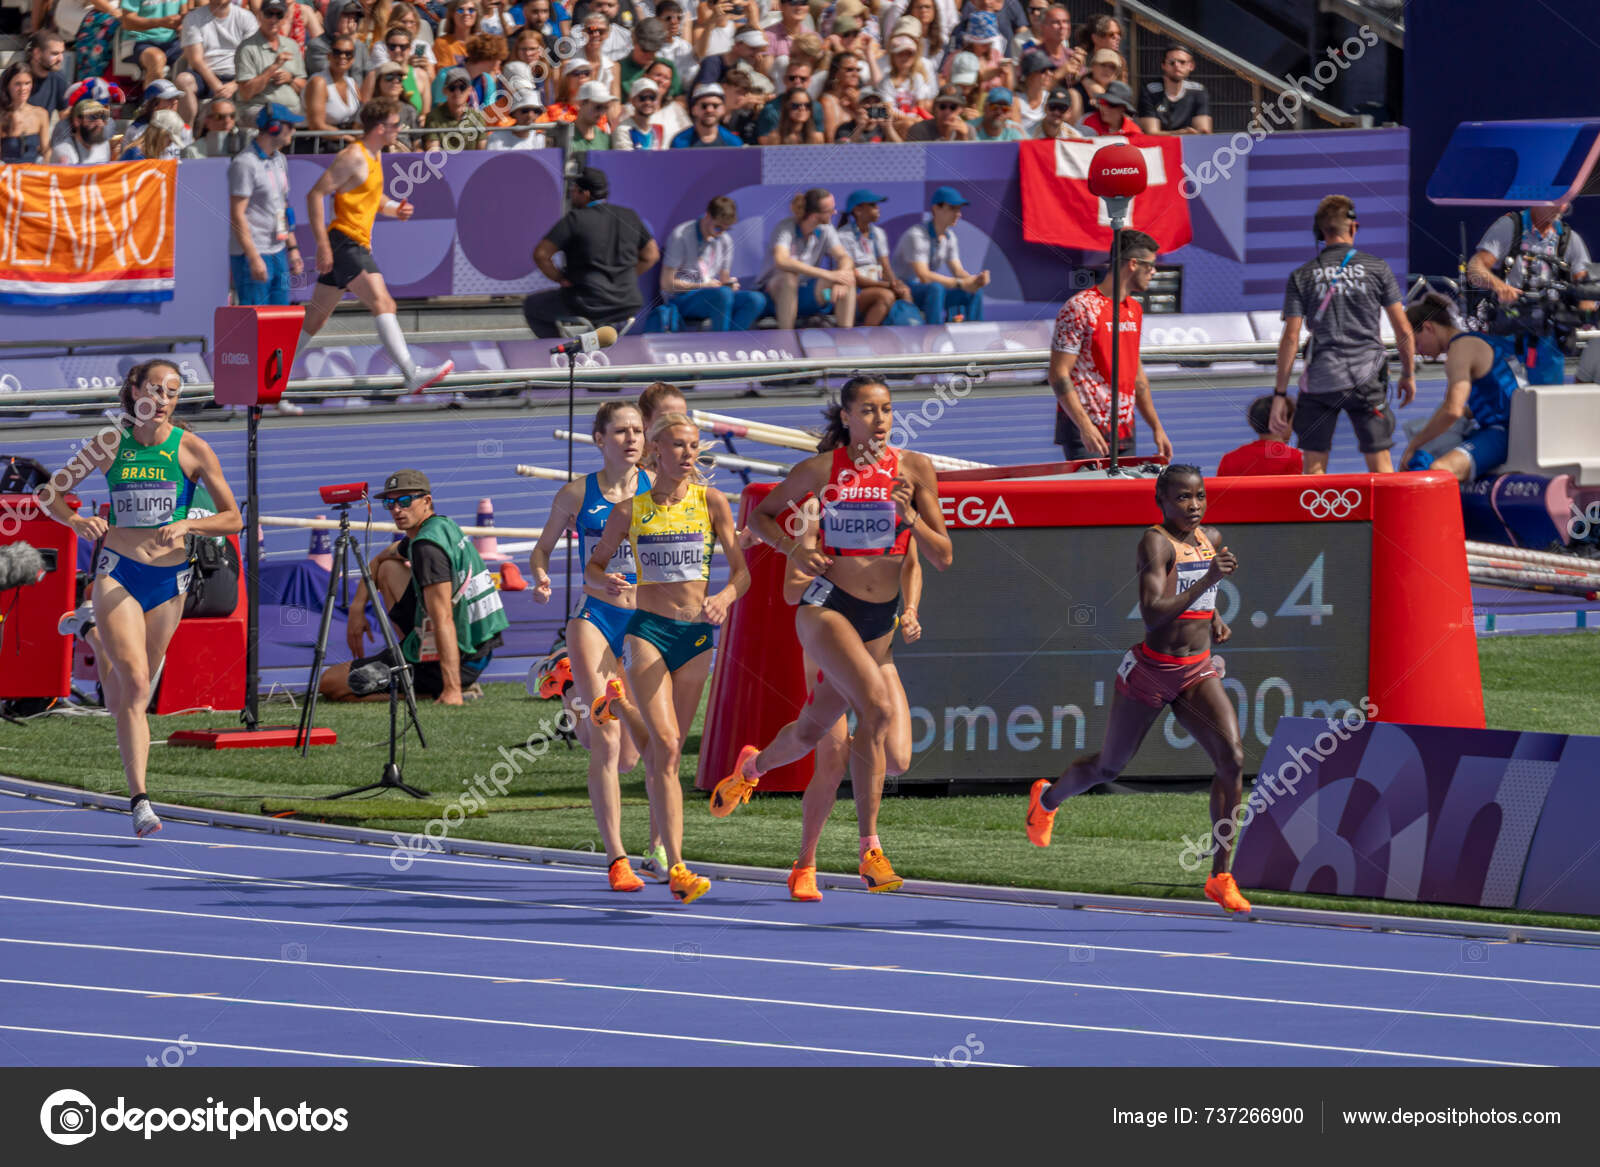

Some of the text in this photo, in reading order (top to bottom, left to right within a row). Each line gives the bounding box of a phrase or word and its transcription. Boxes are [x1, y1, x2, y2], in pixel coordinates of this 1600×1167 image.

[121, 468, 167, 481] BRASIL
[840, 487, 888, 500] SUISSE
[117, 497, 173, 512] DE LIMA
[940, 496, 1015, 526] EGA
[830, 518, 891, 533] WERRO
[98, 556, 109, 569] 2
[640, 550, 702, 567] CALDWELL
[810, 582, 824, 598] 7
